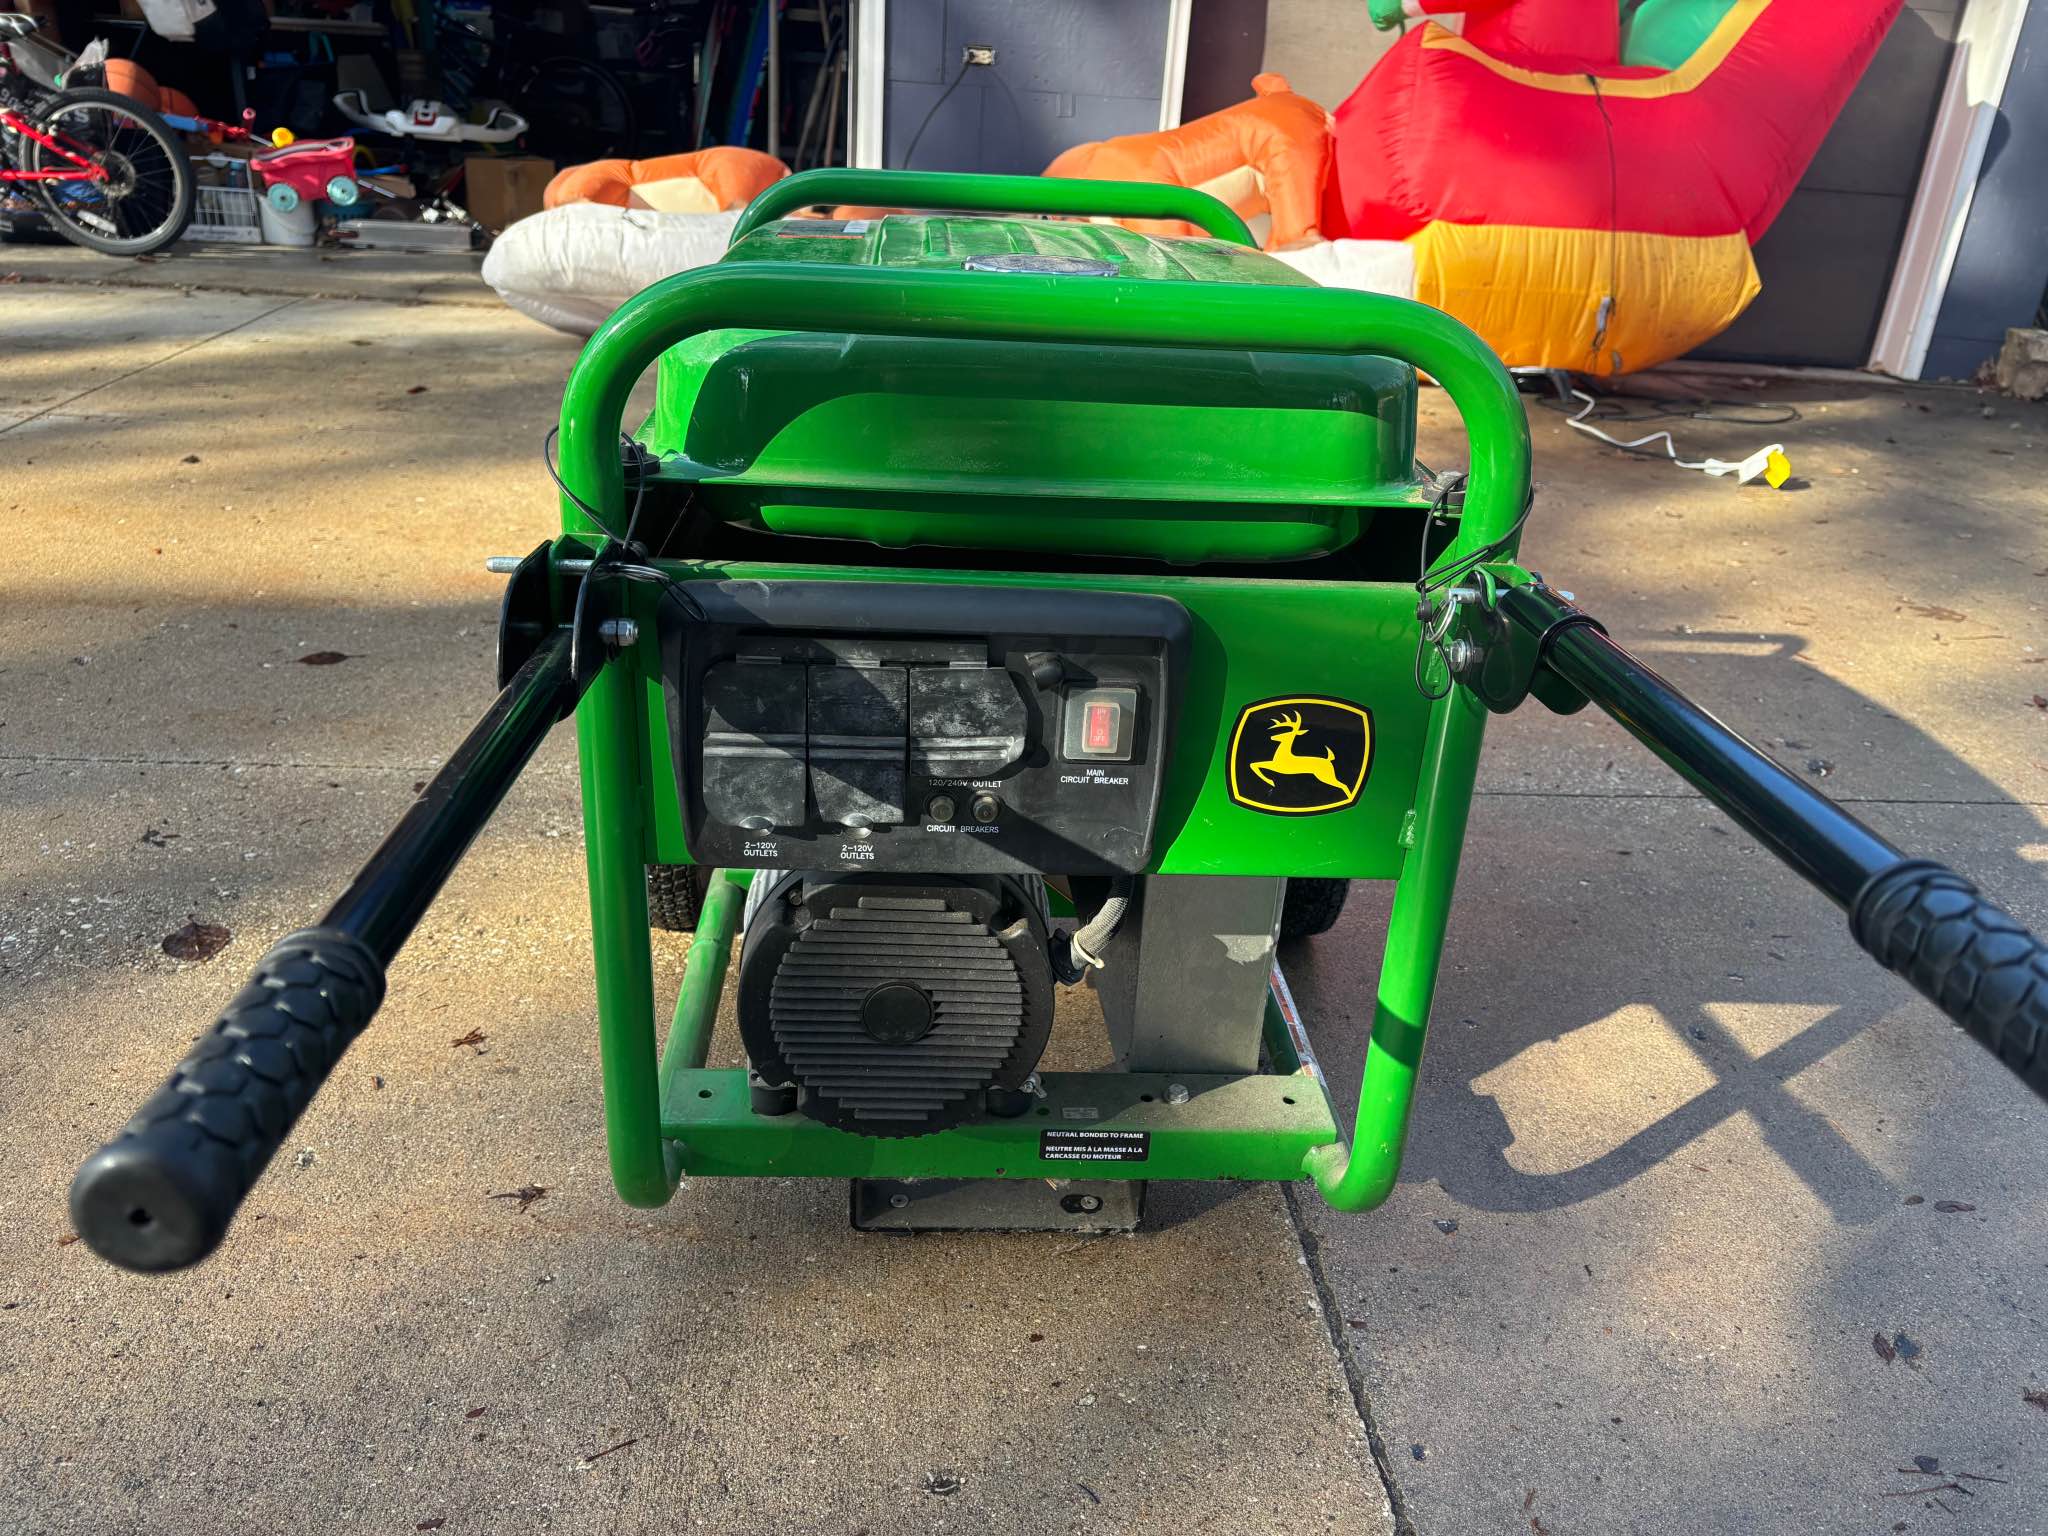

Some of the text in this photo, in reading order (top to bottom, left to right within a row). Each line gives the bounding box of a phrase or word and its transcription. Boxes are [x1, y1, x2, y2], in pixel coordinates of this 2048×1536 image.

[1086, 769, 1105, 777] MAIN
[972, 780, 1002, 788] OUTLET
[1060, 776, 1129, 785] CIRCUIT BREAKER
[926, 825, 999, 834] CIRCUIT BREAKERS
[743, 849, 778, 857] OUTLETS
[840, 852, 875, 860] OUTLETS
